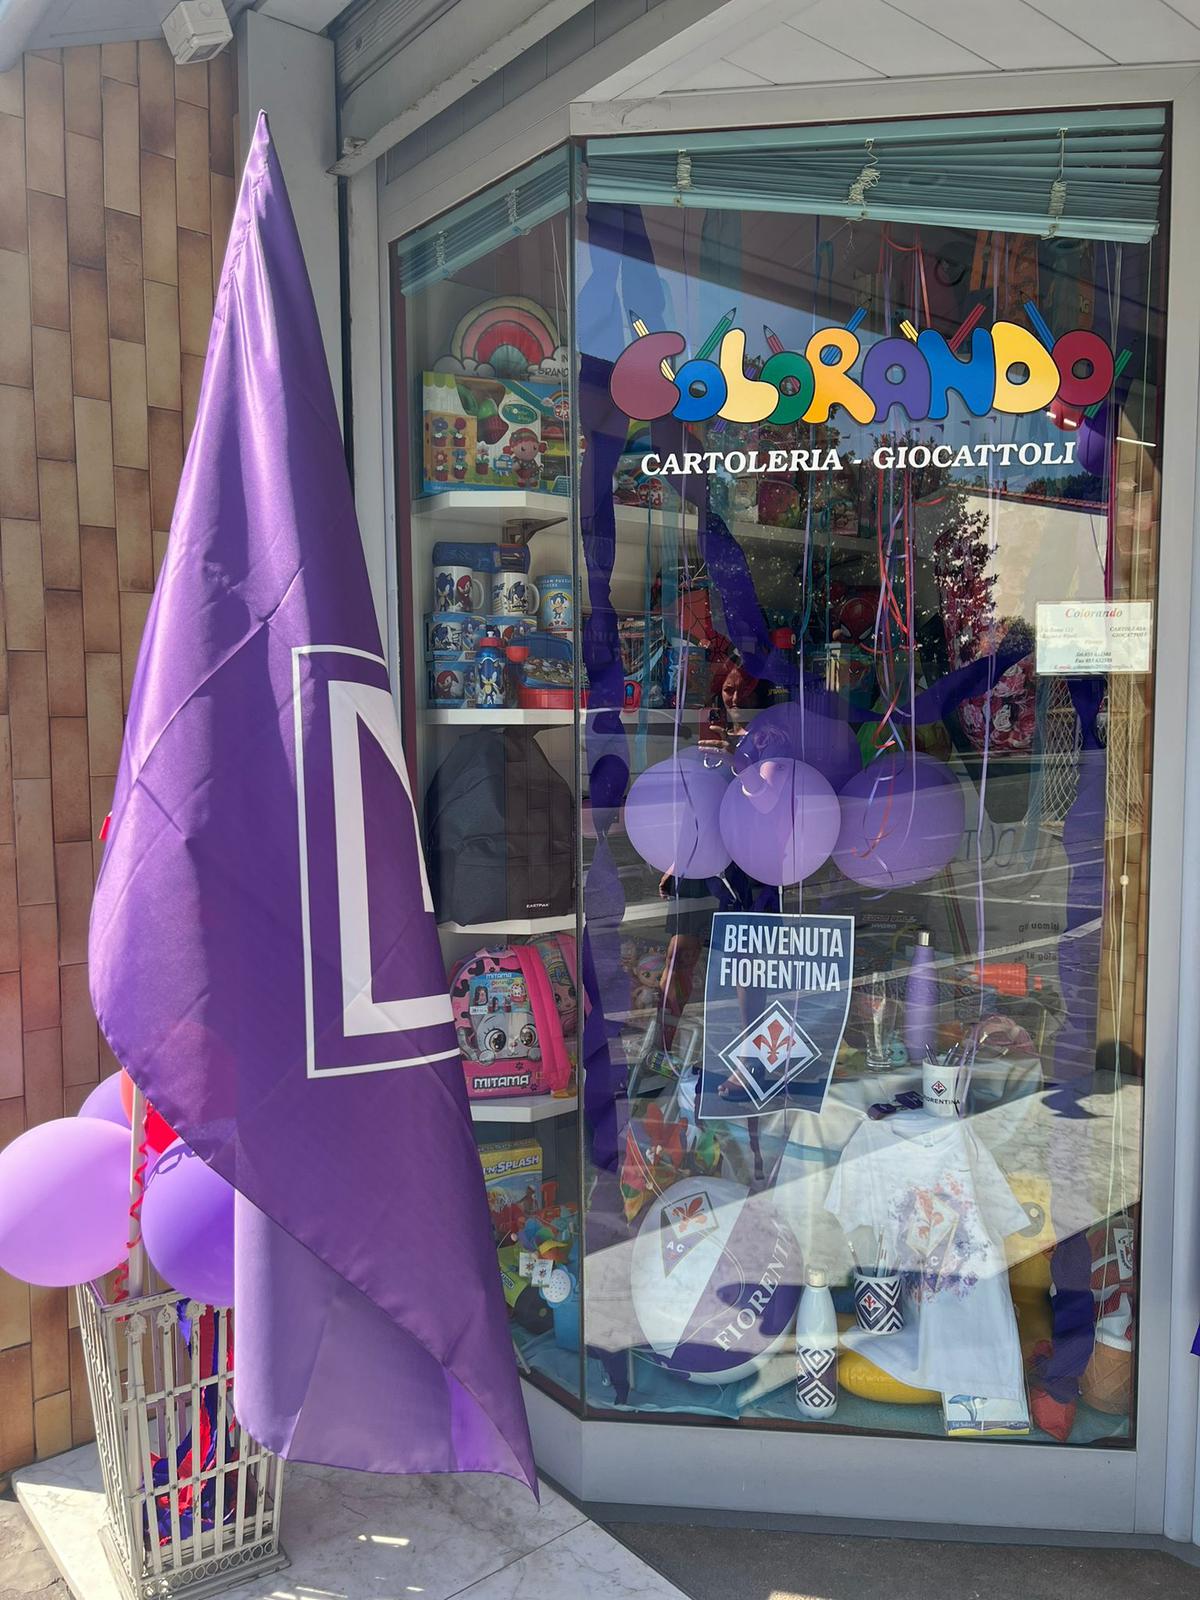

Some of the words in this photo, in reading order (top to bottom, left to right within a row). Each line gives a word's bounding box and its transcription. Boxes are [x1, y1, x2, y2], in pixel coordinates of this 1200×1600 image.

[641, 449, 843, 476] CARTOLERIA
[873, 441, 1077, 470] GIOCATTOLI
[1065, 607, 1123, 618] Colorando
[723, 924, 844, 957] BENVENUTA
[720, 957, 841, 992] FIORENTINA
[474, 1074, 530, 1089] MITAMA
